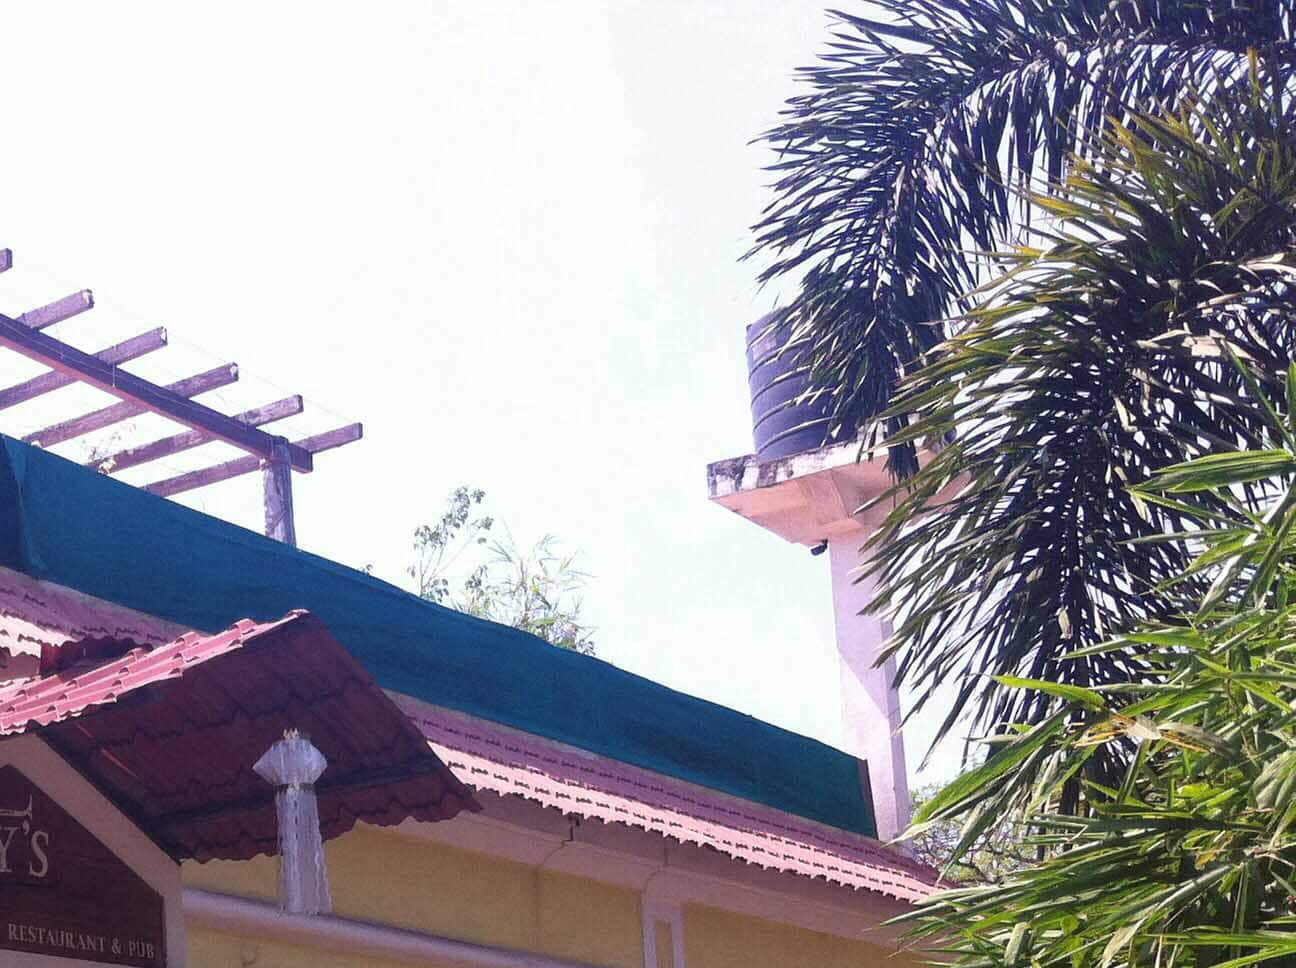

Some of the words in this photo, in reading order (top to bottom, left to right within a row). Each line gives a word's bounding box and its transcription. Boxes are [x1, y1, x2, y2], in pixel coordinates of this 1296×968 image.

[7, 923, 105, 953] RESTAURANT
[111, 937, 122, 954] &
[128, 939, 155, 959] PUB
